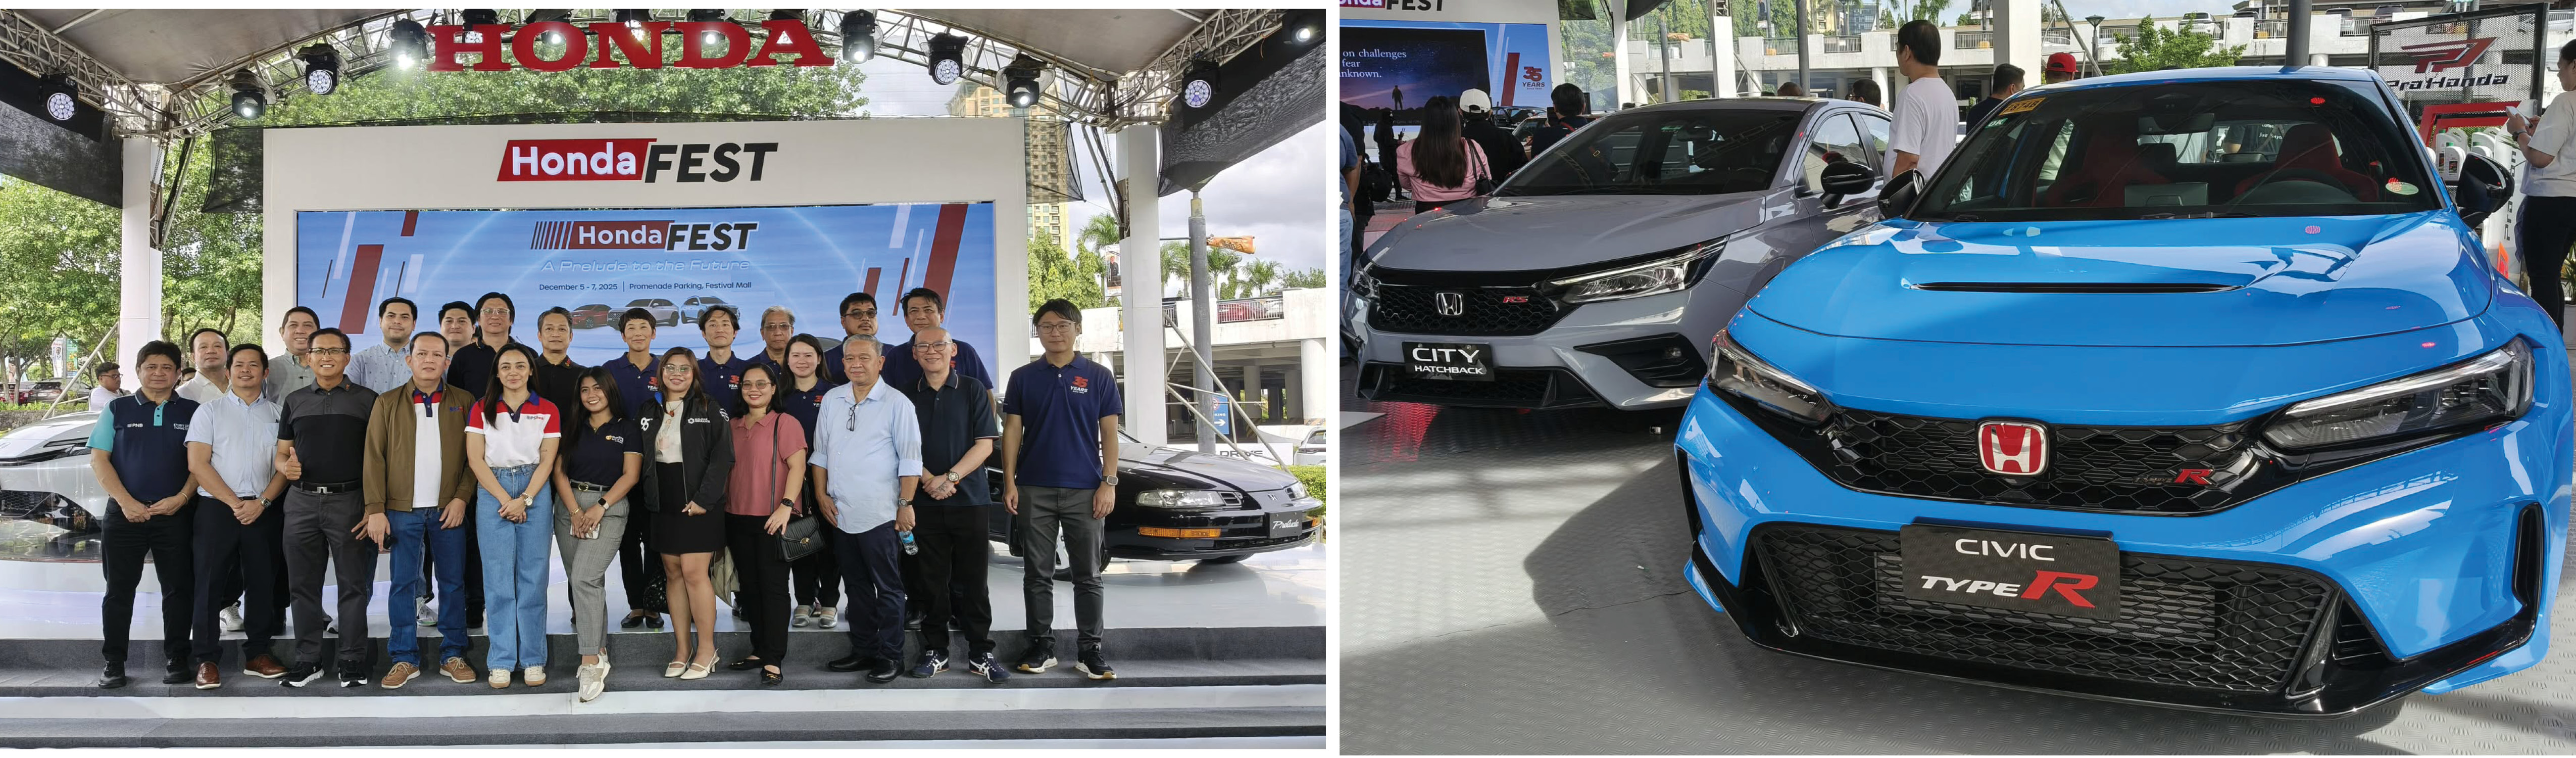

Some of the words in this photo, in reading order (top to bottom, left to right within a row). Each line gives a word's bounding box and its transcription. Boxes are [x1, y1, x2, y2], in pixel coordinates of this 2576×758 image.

[426, 19, 834, 72] HONDA
[1358, 49, 1407, 60] challenges
[1342, 58, 1360, 67] fear
[1522, 66, 1542, 81] 35
[513, 142, 635, 175] Honda
[645, 143, 778, 183] FEST
[579, 225, 662, 244] Honda
[667, 223, 758, 251] FEST
[541, 260, 555, 271] A
[560, 260, 627, 272] Prelude
[632, 260, 651, 271] to
[656, 260, 685, 271] the
[690, 259, 750, 270] Future
[1412, 348, 1479, 363] CITY
[1414, 365, 1484, 374] HATCHBACK
[1072, 376, 1088, 388] 35
[1272, 518, 1299, 530] Prelude
[1955, 539, 2055, 561] CIVIC
[1921, 576, 2020, 597] TYPE
[2020, 570, 2099, 608] R
